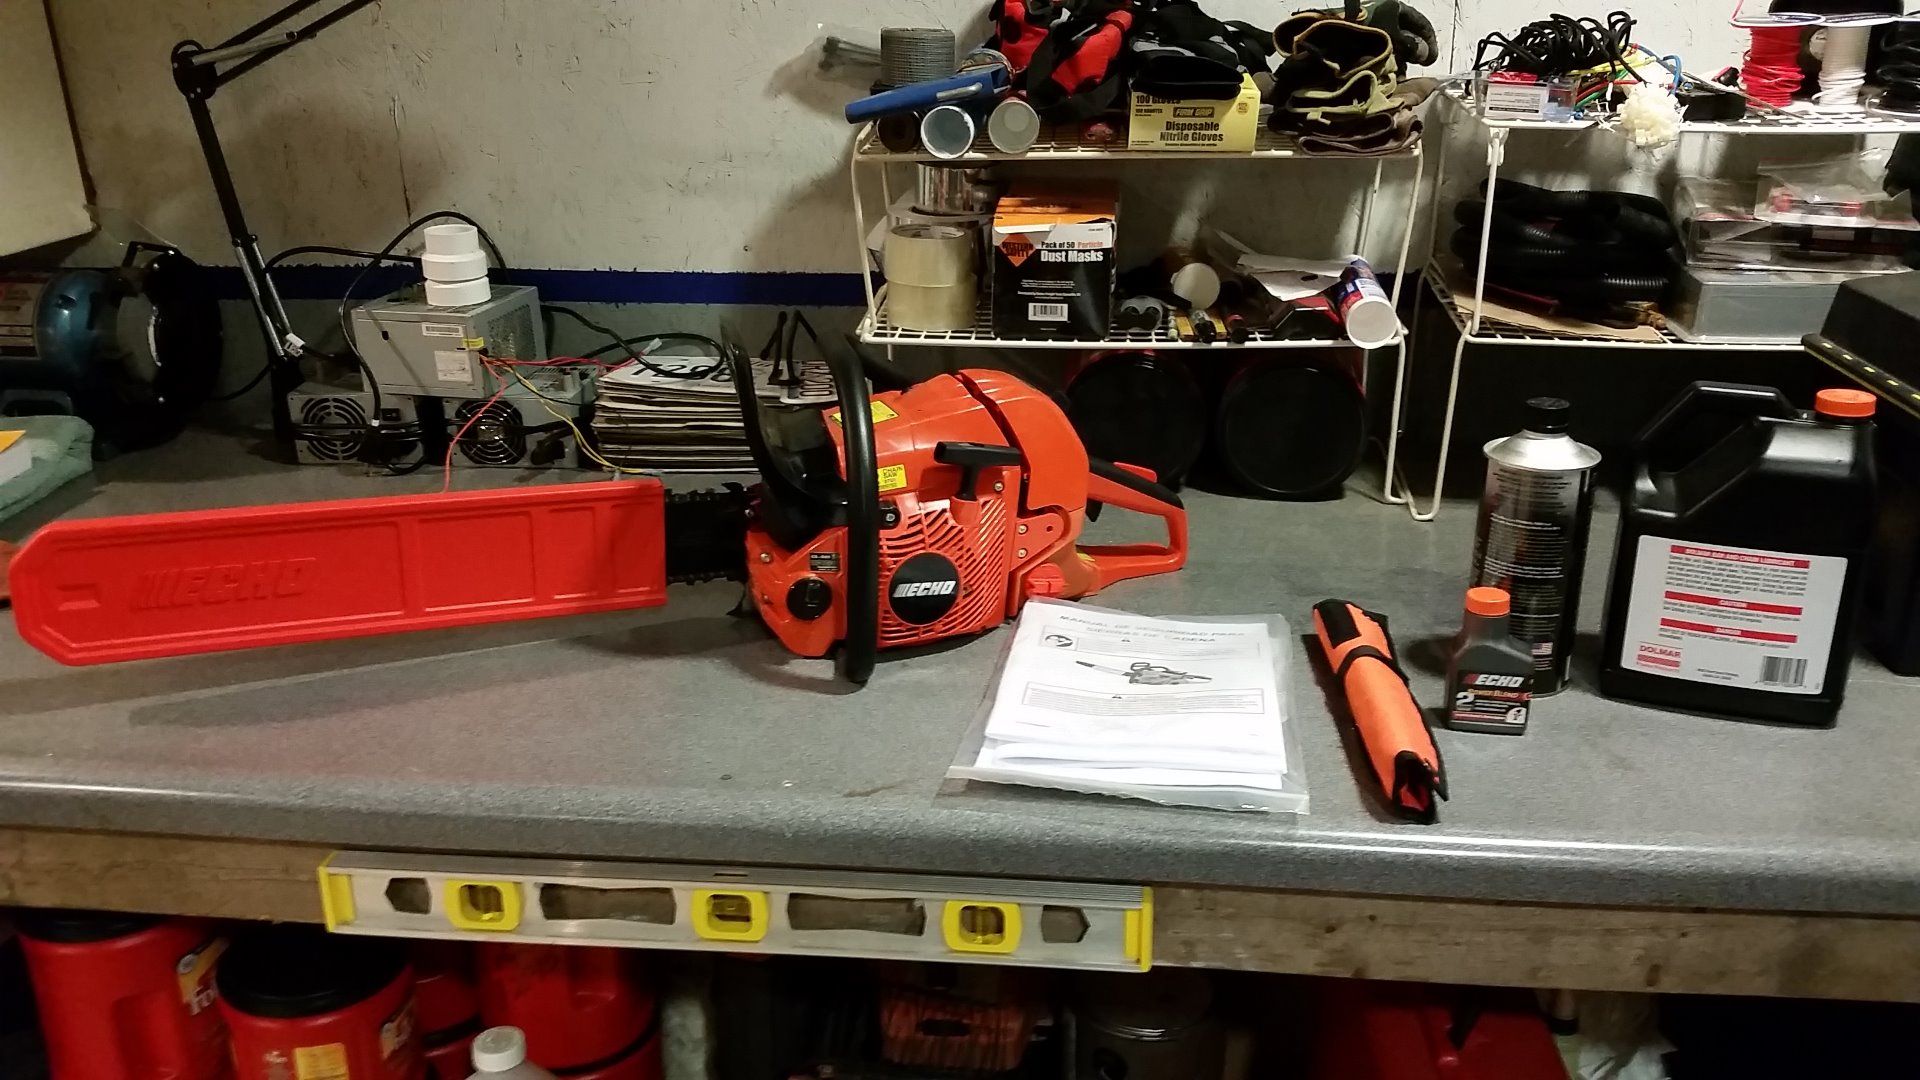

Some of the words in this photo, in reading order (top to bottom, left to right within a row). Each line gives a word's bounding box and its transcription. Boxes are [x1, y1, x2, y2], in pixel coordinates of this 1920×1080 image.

[1136, 95, 1150, 104] 100
[1165, 121, 1220, 132] Disposable
[1160, 132, 1189, 141] Nitrile
[1191, 132, 1224, 142] Gloves
[1040, 250, 1066, 262] Dust
[1067, 250, 1104, 262] Masks
[906, 580, 957, 597] ECHO
[1639, 645, 1681, 658] DOLMAR
[1473, 673, 1525, 688] ECHO
